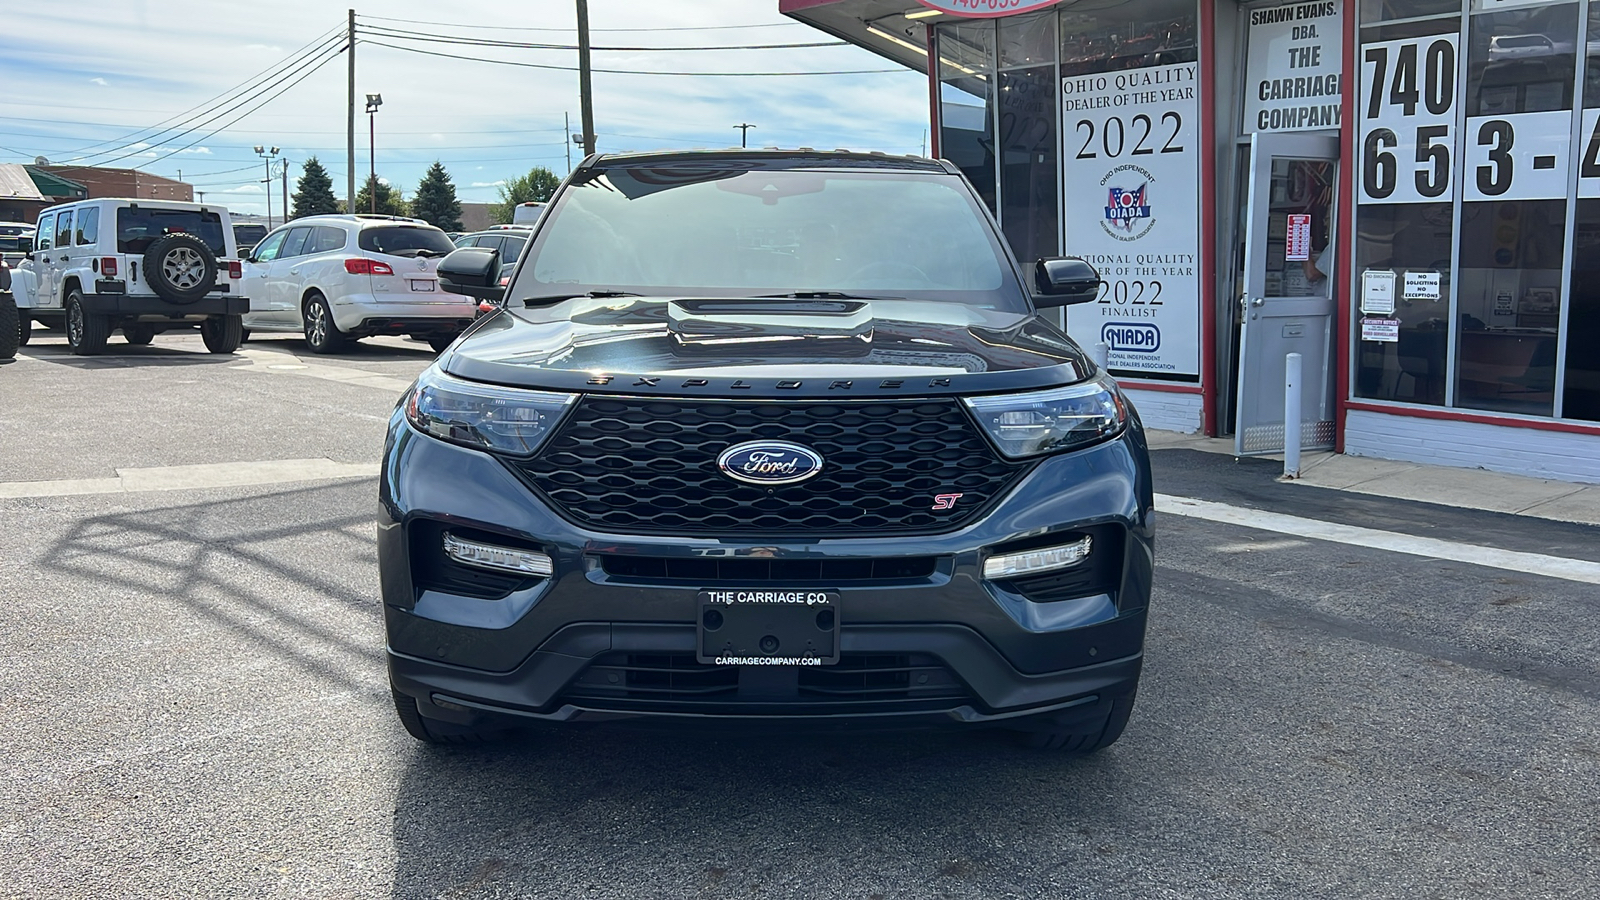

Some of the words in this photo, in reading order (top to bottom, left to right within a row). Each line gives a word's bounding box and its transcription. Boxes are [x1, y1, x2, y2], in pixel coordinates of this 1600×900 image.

[1251, 7, 1294, 26] SHAWN
[1296, 2, 1337, 20] EVANS.
[1291, 24, 1319, 41] DBA.
[1288, 45, 1321, 69] THE
[1063, 77, 1107, 95] OHIO
[1115, 66, 1196, 90] QUALITY
[1365, 39, 1455, 119] 740
[1065, 96, 1111, 112] DEALER
[1113, 93, 1130, 107] OF
[1132, 90, 1157, 105] THE
[1160, 86, 1194, 102] YEAR
[1257, 103, 1342, 130] COMPANY
[1075, 111, 1184, 160] 2022
[1100, 170, 1114, 187] OHIO
[1113, 164, 1156, 184] INDEPENDENT
[1110, 207, 1143, 219] OIADA
[1079, 254, 1131, 264] TIONAL
[1136, 254, 1194, 265] QUALITY
[1115, 267, 1130, 276] OF
[1134, 267, 1157, 276] THE
[1162, 267, 1193, 276] YEAR
[1097, 280, 1163, 305] 2022
[1101, 307, 1158, 318] FINALIST
[1106, 328, 1155, 349] NIADA
[586, 374, 952, 390] EXPLORER
[742, 450, 799, 475] Ford
[931, 493, 963, 510] ST
[707, 591, 734, 604] THE
[737, 592, 805, 604] CARRIAGE
[806, 592, 830, 604] CO.
[715, 656, 821, 666] CARRIAGECOMPANY.COM
